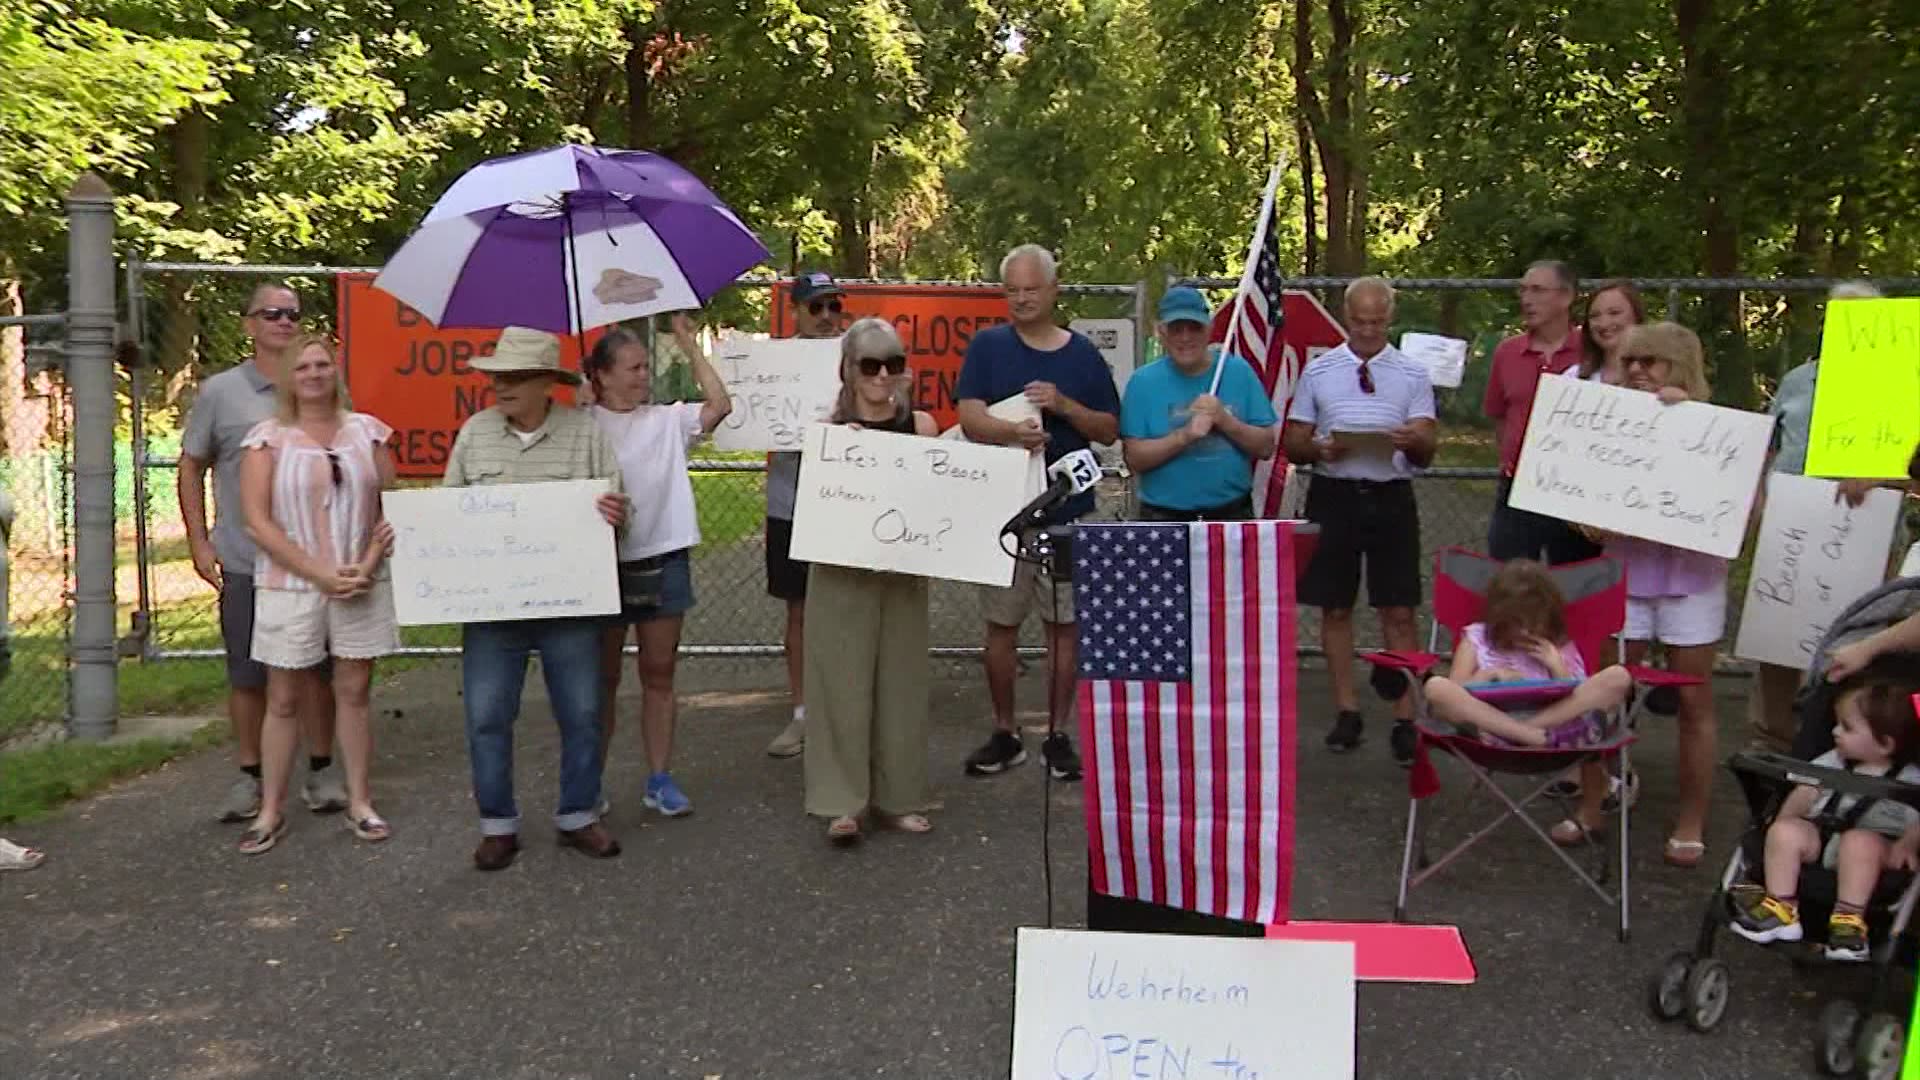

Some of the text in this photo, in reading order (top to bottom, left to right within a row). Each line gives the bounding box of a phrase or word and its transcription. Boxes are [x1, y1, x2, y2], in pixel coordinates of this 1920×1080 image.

[894, 313, 1010, 356] CLOS
[1546, 385, 1664, 432] Hottest
[925, 449, 991, 482] Beach
[1071, 459, 1092, 487] 12
[1753, 526, 1807, 606] Beach
[1086, 951, 1249, 1004] Wehrheim
[1054, 1025, 1257, 1080] OPEN th
